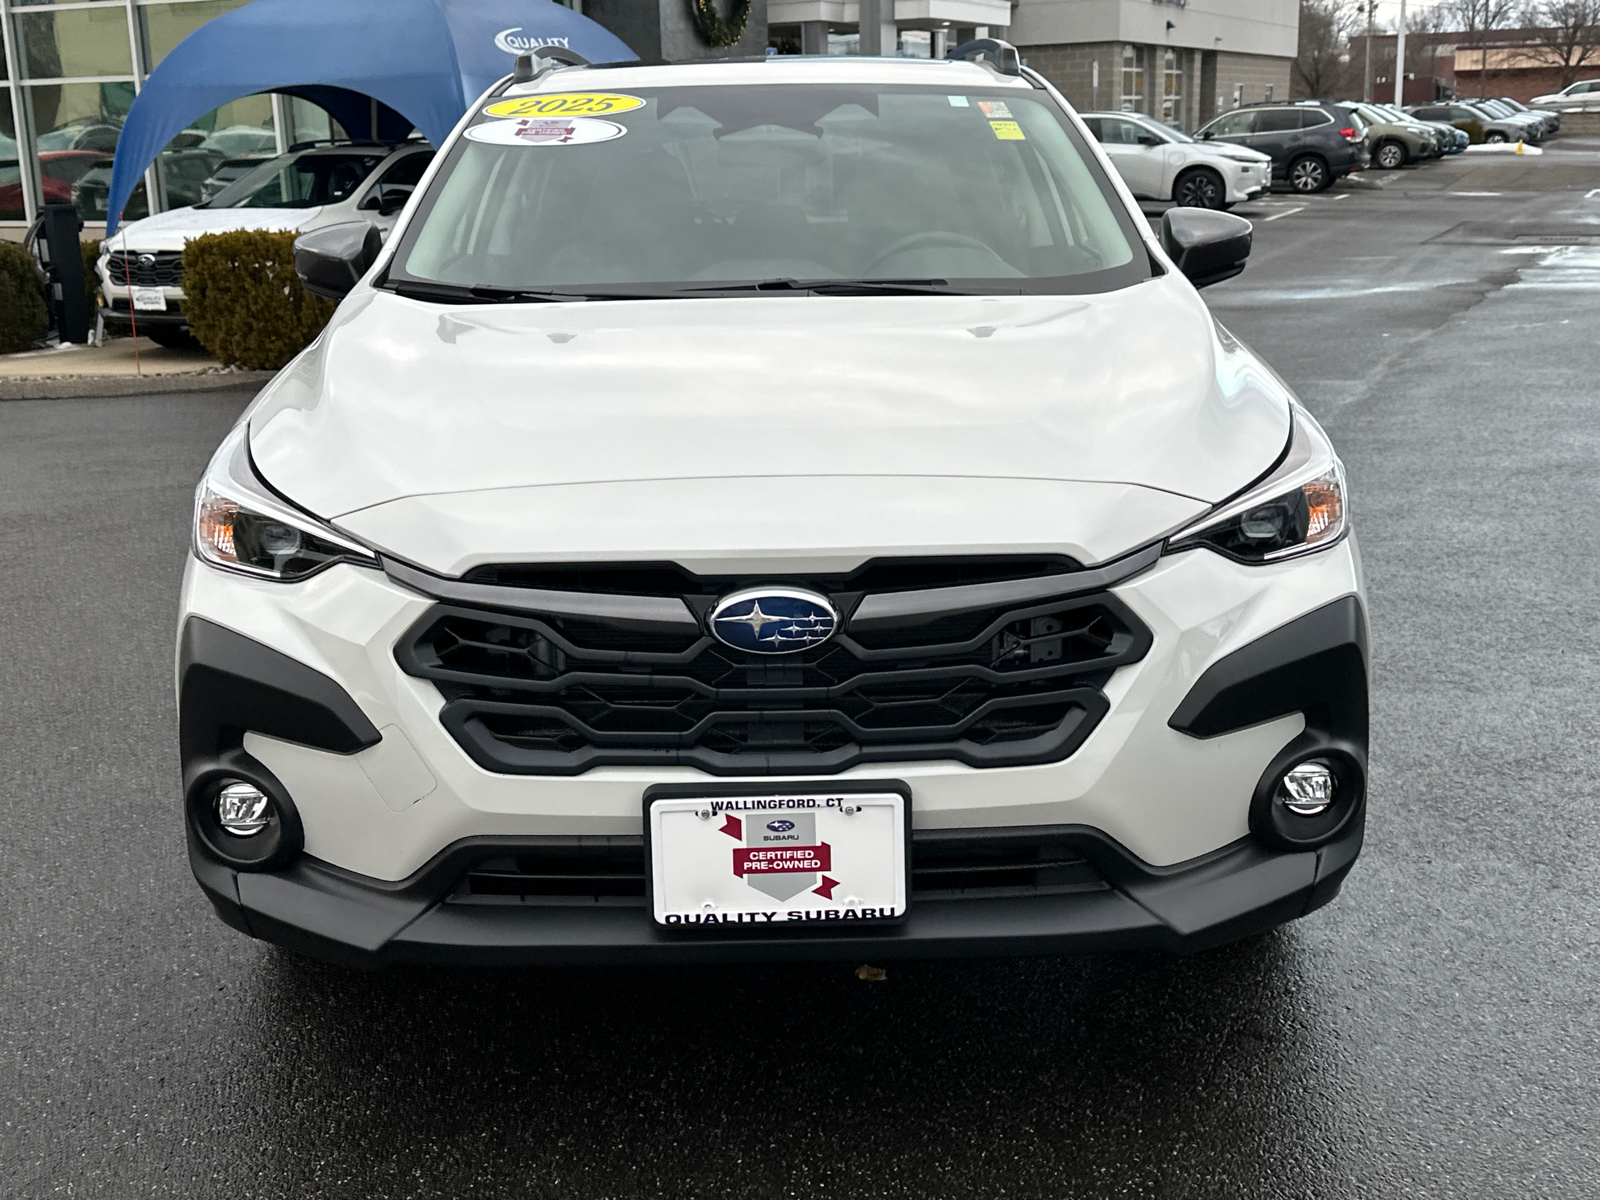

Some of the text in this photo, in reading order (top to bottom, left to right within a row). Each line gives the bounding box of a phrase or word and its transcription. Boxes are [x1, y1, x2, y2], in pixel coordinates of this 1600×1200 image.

[507, 97, 620, 115] 2025
[710, 798, 844, 811] WALLINGFORD, CT
[749, 850, 815, 861] CERTIFIED
[743, 859, 821, 871] PRE-OWNED
[665, 907, 895, 925] QUALITY SUBARU
